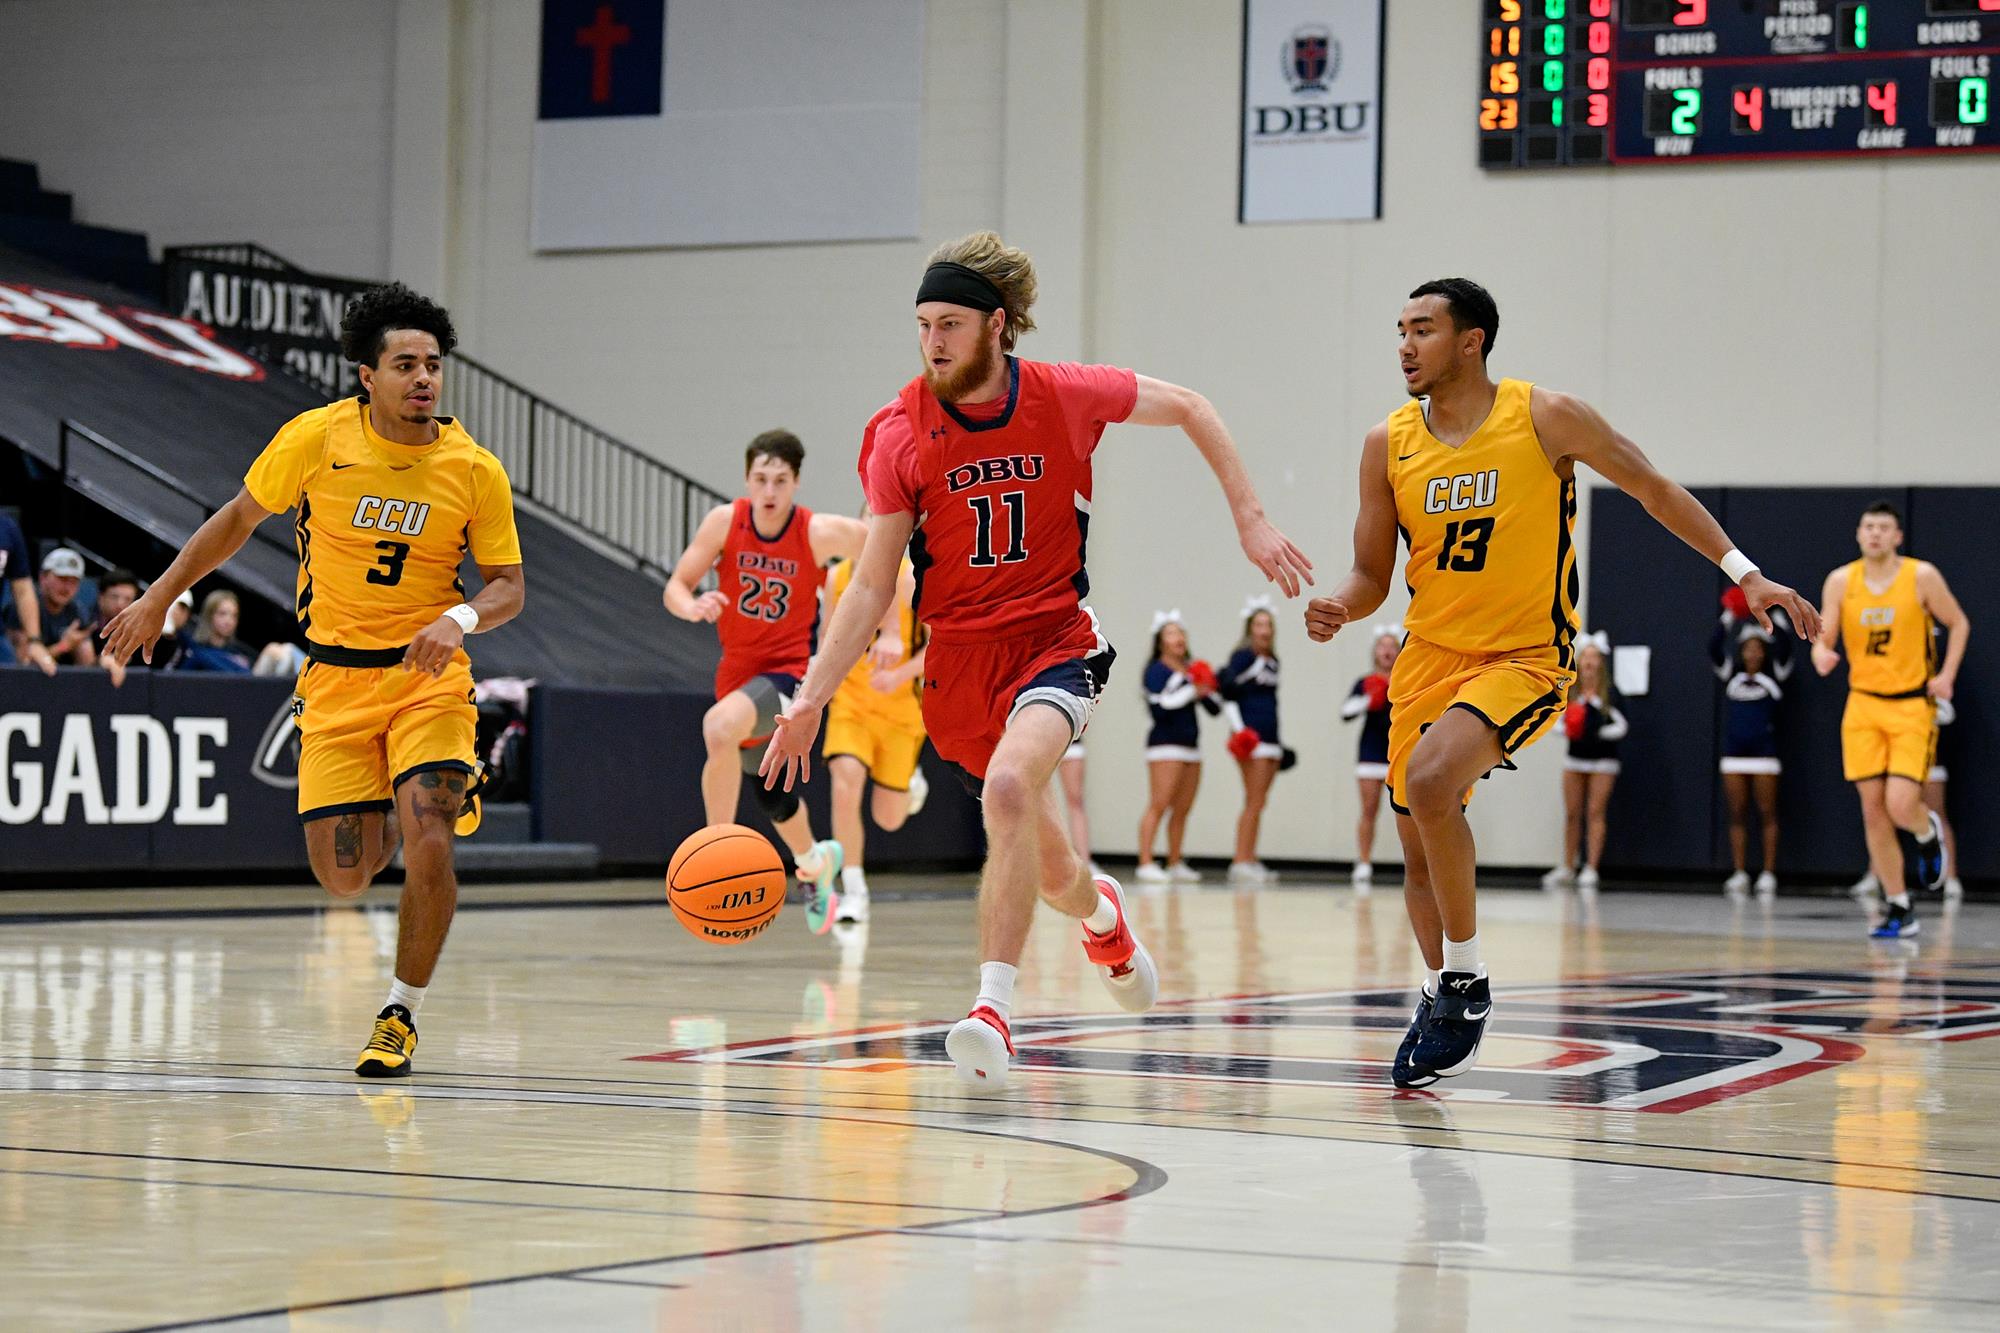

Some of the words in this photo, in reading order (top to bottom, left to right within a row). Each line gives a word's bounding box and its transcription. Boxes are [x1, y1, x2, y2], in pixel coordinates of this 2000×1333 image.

[1491, 26, 1520, 57] 11
[1544, 24, 1565, 55] 0
[1589, 21, 1610, 53] 0
[1764, 14, 1833, 38] PERIOD
[1854, 5, 1867, 48] 1
[1917, 20, 1982, 45] BONUS
[1655, 32, 1717, 56] BONUS
[1490, 61, 1519, 94] 15
[1543, 60, 1564, 91] 0
[1587, 57, 1609, 90] 0
[1645, 67, 1702, 90] FOULS
[1930, 55, 1990, 79] FOULS
[1552, 96, 1563, 127] 1
[1586, 93, 1608, 126] 3
[1671, 88, 1700, 135] 2
[1733, 86, 1762, 132] 4
[1769, 85, 1861, 109] TIMEOUTS
[1867, 81, 1897, 126] 4
[1959, 77, 1988, 124] 0
[1252, 102, 1370, 136] DBU
[1479, 98, 1518, 130] 23
[1791, 107, 1836, 129] LEFT
[1654, 136, 1694, 156] WON
[1857, 127, 1907, 149] GAME
[1935, 125, 1976, 146] WON
[181, 269, 362, 342] AUDIEN
[945, 455, 1044, 493] DBU
[1425, 469, 1498, 514] CCU
[352, 495, 430, 536] CCU
[968, 490, 1028, 567] 11
[1436, 517, 1495, 571] 13
[366, 540, 410, 586] 3
[737, 551, 799, 577] DBU
[738, 572, 791, 623] 23
[1865, 629, 1891, 656] 12
[0, 711, 228, 825] GADE
